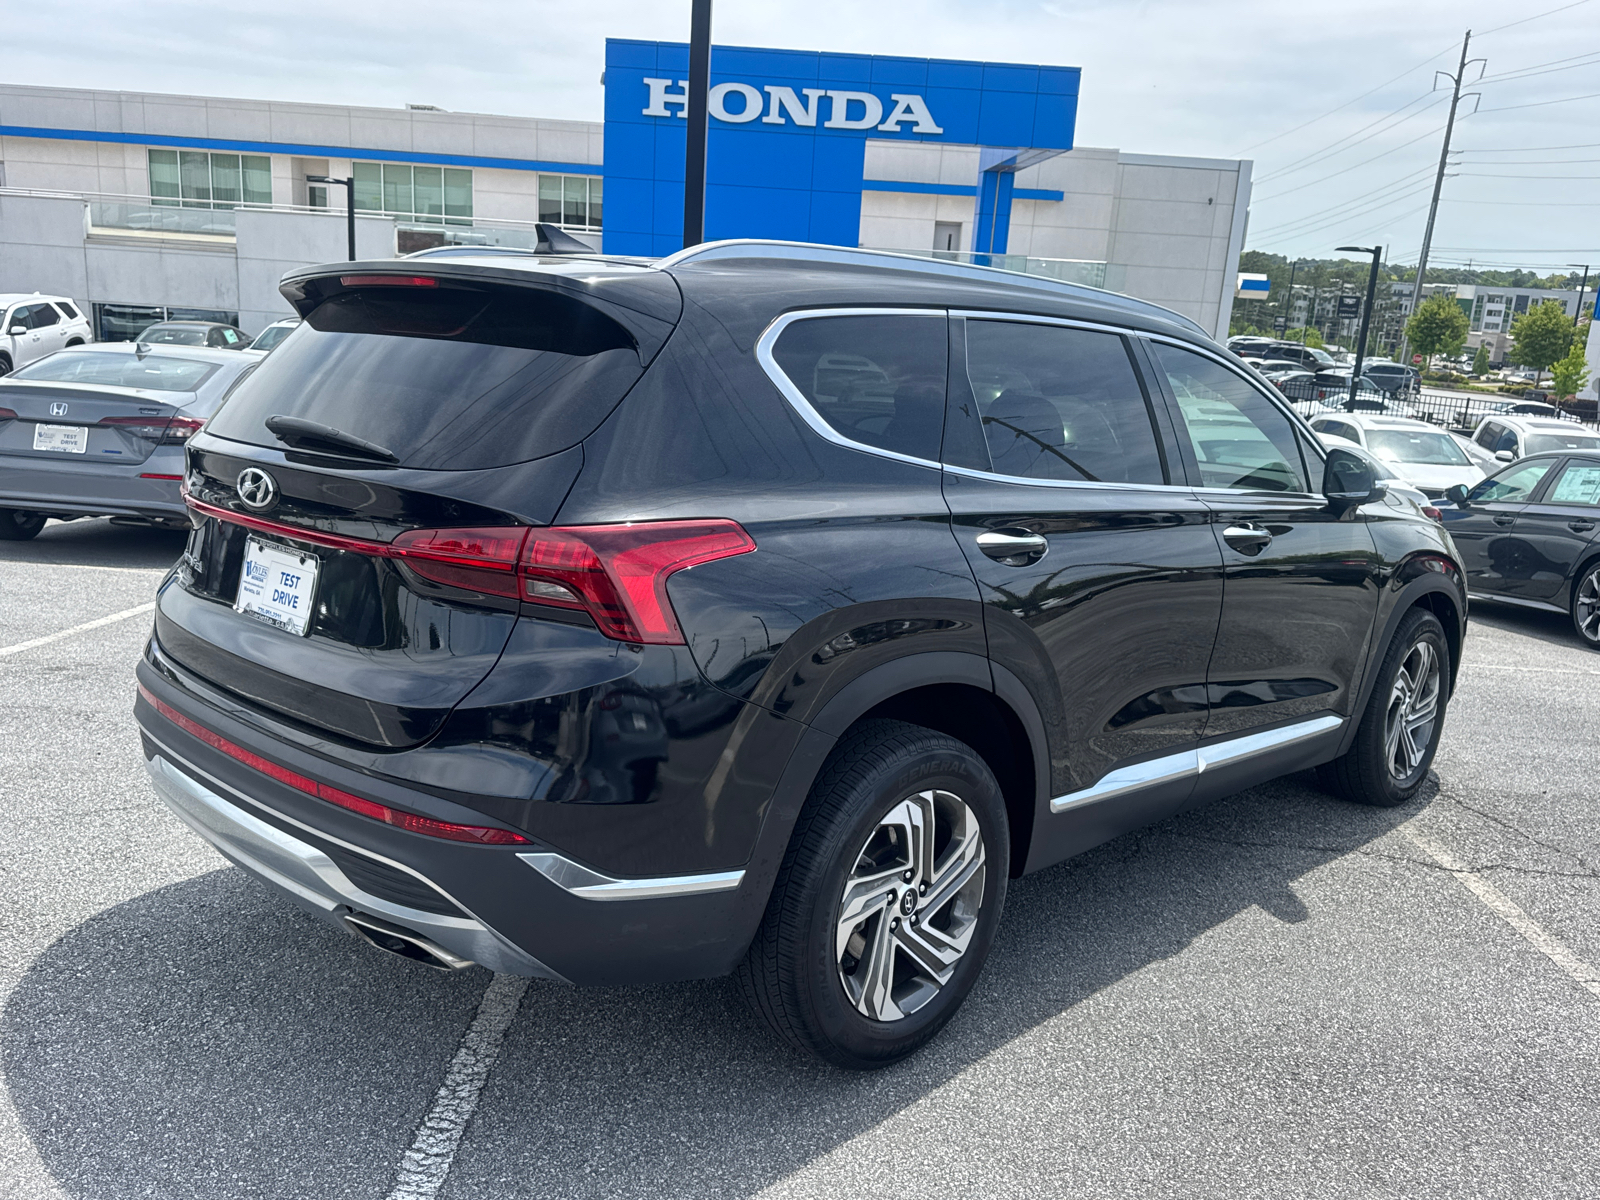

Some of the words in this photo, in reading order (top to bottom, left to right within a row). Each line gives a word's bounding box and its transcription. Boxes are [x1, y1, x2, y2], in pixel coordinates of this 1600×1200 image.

[642, 77, 943, 134] HONDA
[280, 571, 301, 589] TEST
[272, 589, 299, 609] DRIVE
[899, 760, 967, 788] GENERAL
